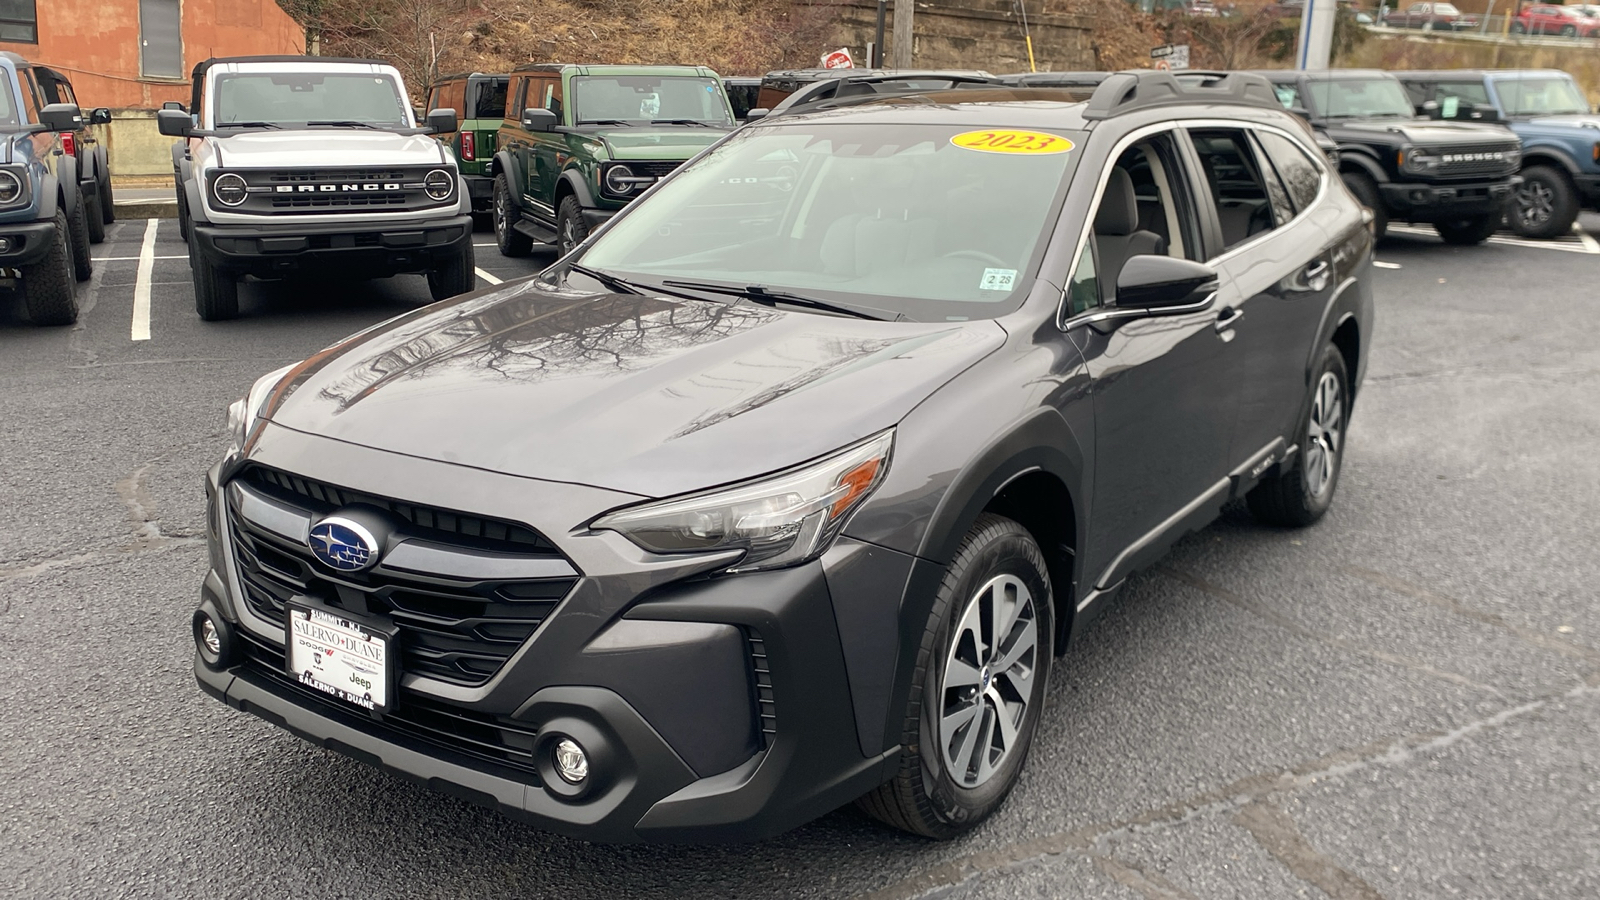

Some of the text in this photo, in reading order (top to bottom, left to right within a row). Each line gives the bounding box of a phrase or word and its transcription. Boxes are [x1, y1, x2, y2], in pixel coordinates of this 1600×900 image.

[966, 133, 1056, 150] 2023
[276, 183, 400, 193] BRONCO
[988, 275, 996, 284] 2
[294, 620, 383, 662] SALERNO DUANE
[349, 672, 372, 691] Jeep
[298, 675, 375, 711] SALERNO DUANE
